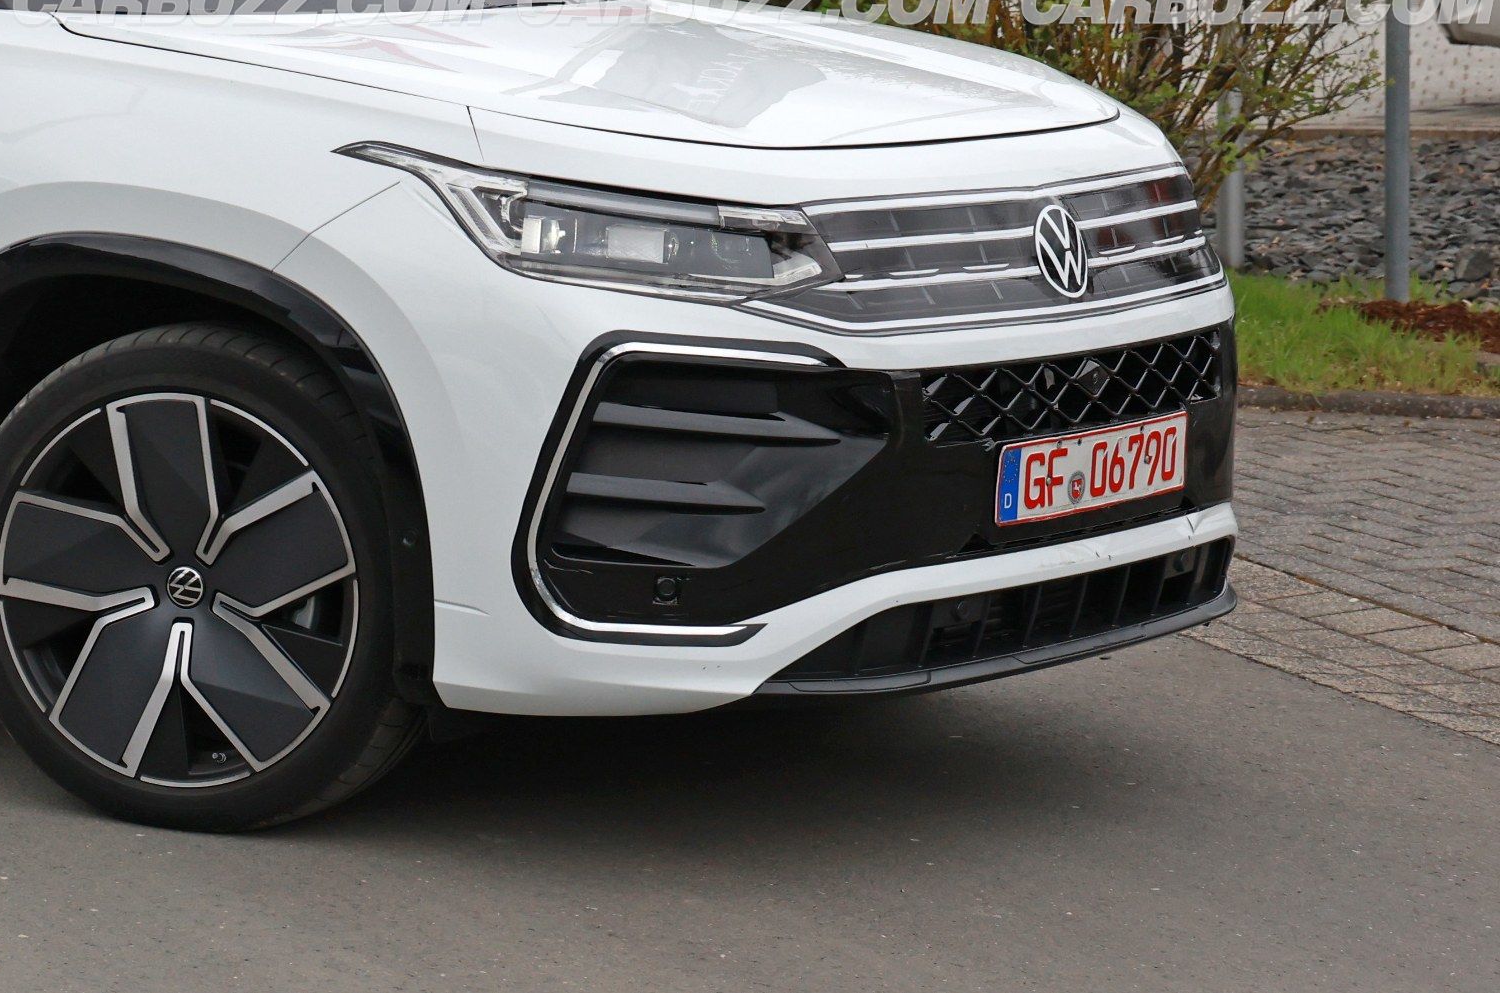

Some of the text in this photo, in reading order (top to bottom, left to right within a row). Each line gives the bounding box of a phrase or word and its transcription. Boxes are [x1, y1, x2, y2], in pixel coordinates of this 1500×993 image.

[1024, 447, 1069, 510] GF
[1090, 426, 1178, 497] 06790
[1004, 493, 1012, 509] D
